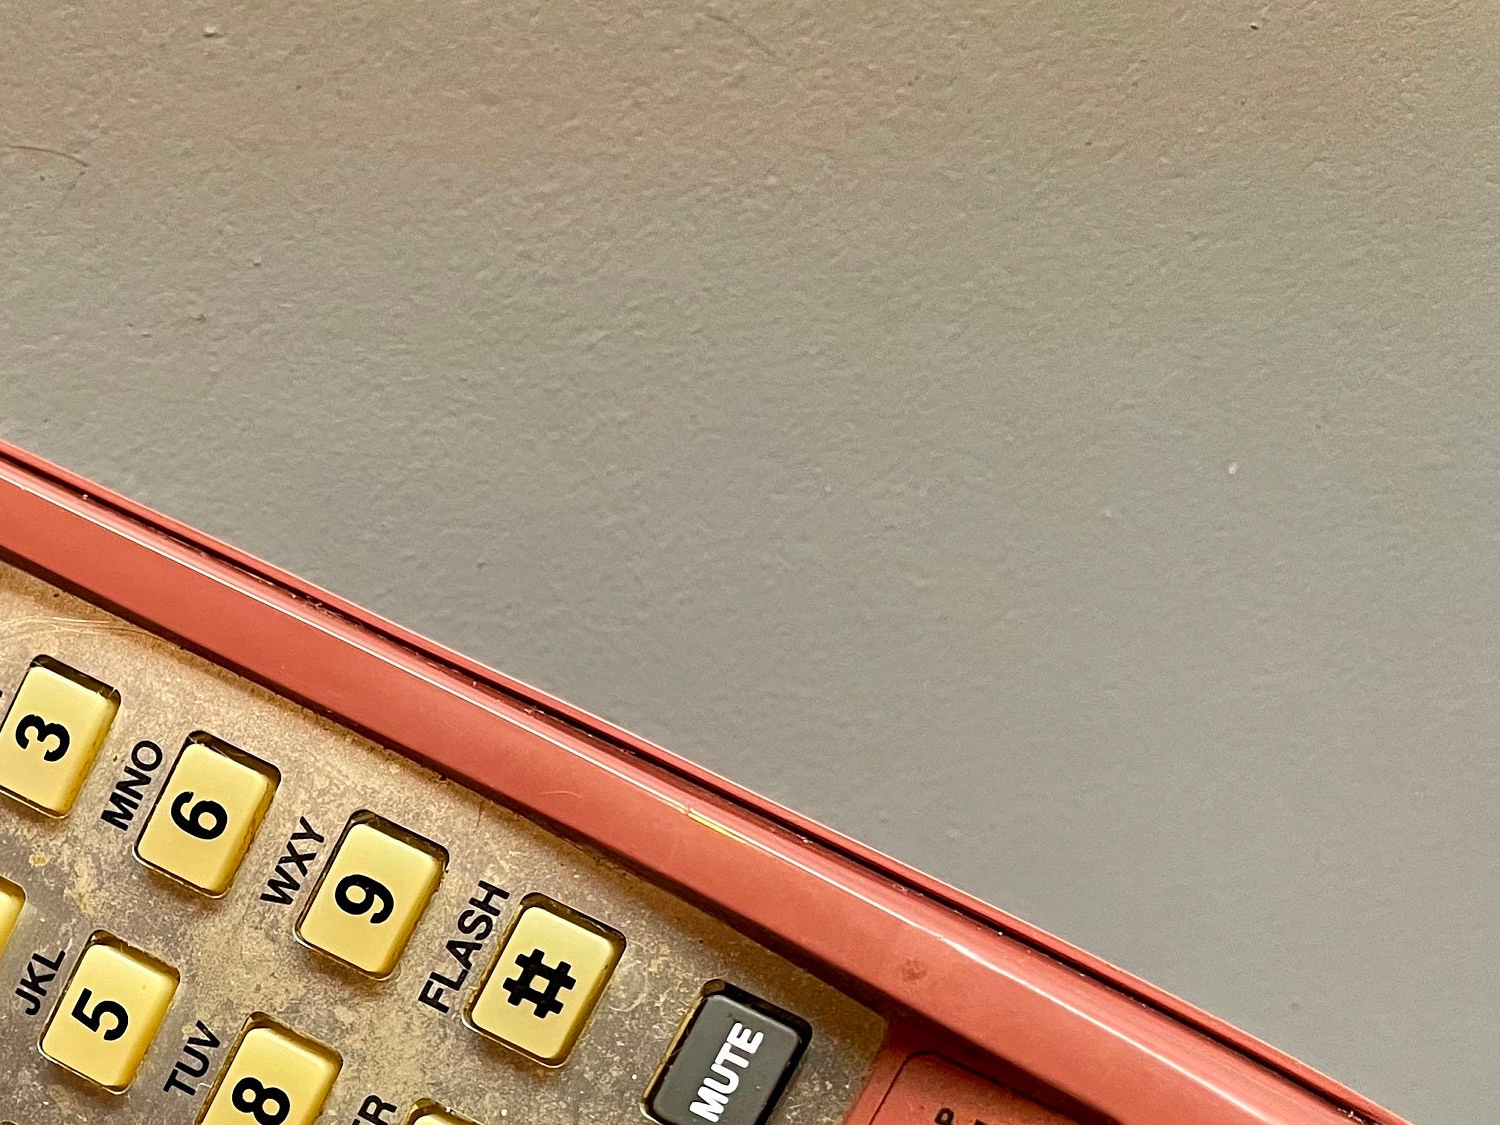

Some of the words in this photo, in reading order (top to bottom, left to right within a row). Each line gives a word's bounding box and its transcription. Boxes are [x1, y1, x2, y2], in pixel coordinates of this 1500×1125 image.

[15, 714, 70, 763] 3
[101, 740, 164, 832] MNO
[171, 791, 228, 841] 6
[260, 816, 327, 910] WXY
[334, 874, 395, 925] 9
[15, 945, 67, 1017] JKL
[417, 880, 510, 1014] FLASH
[72, 988, 129, 1042] 5
[501, 948, 577, 1019] #
[162, 1021, 224, 1102] TUV
[689, 1022, 765, 1123] MUTE
